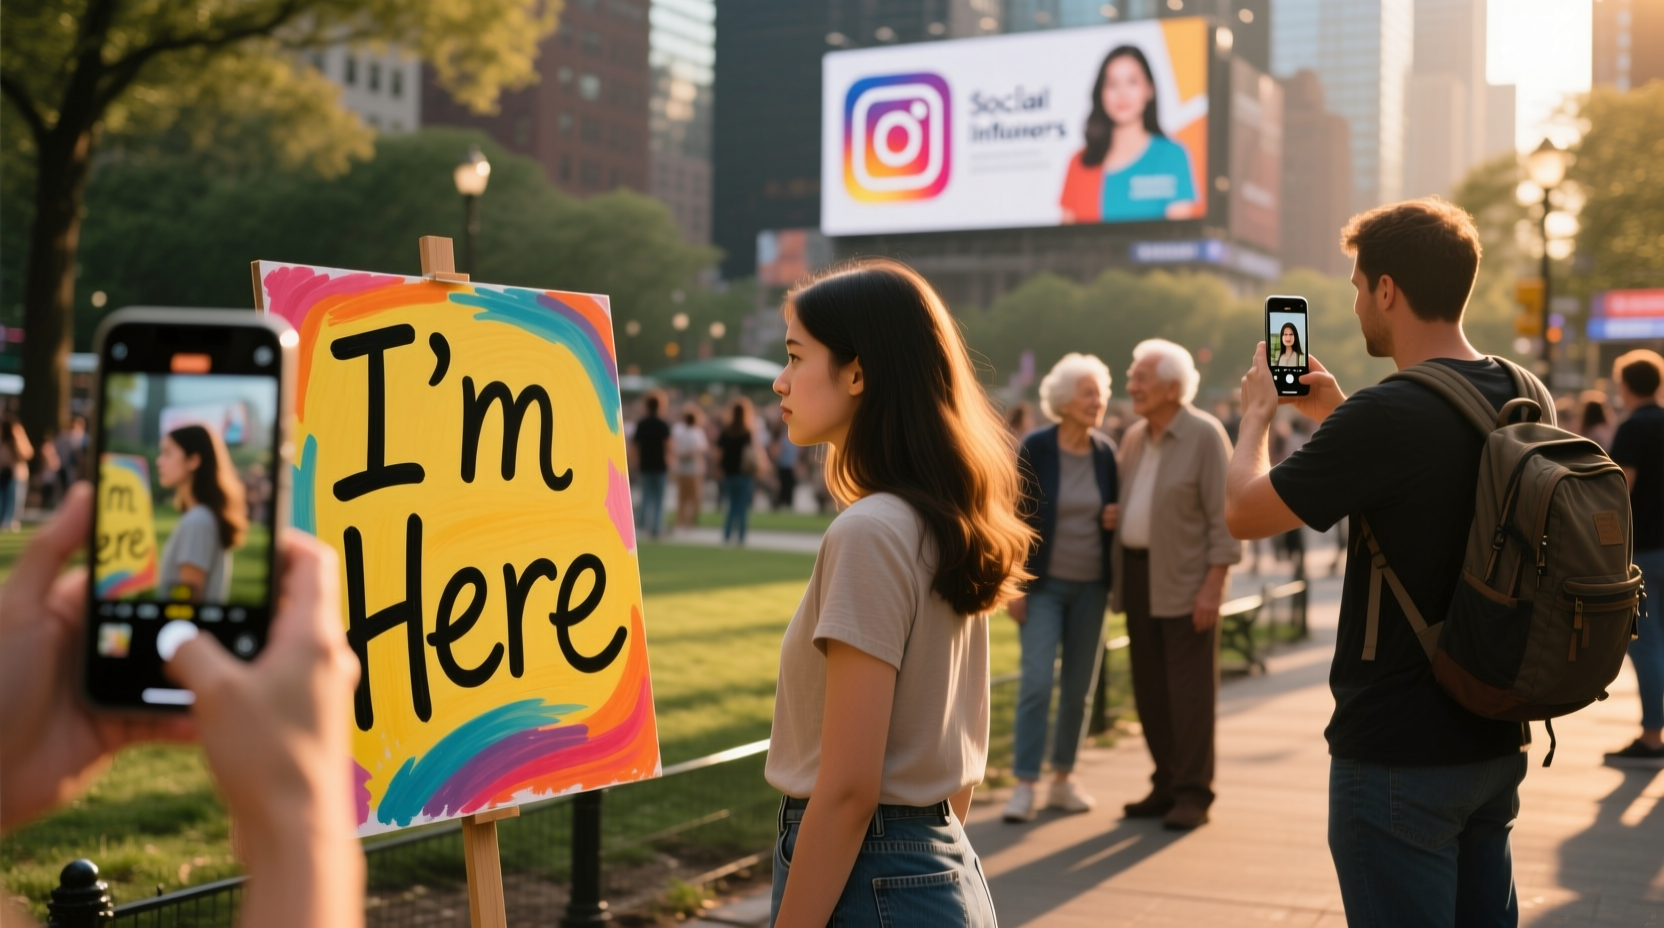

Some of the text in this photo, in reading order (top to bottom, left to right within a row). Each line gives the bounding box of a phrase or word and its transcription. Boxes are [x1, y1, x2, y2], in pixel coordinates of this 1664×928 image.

[969, 84, 1051, 117] Social
[330, 323, 574, 502] I'm
[97, 527, 149, 566] ere
[343, 512, 628, 732] Here
